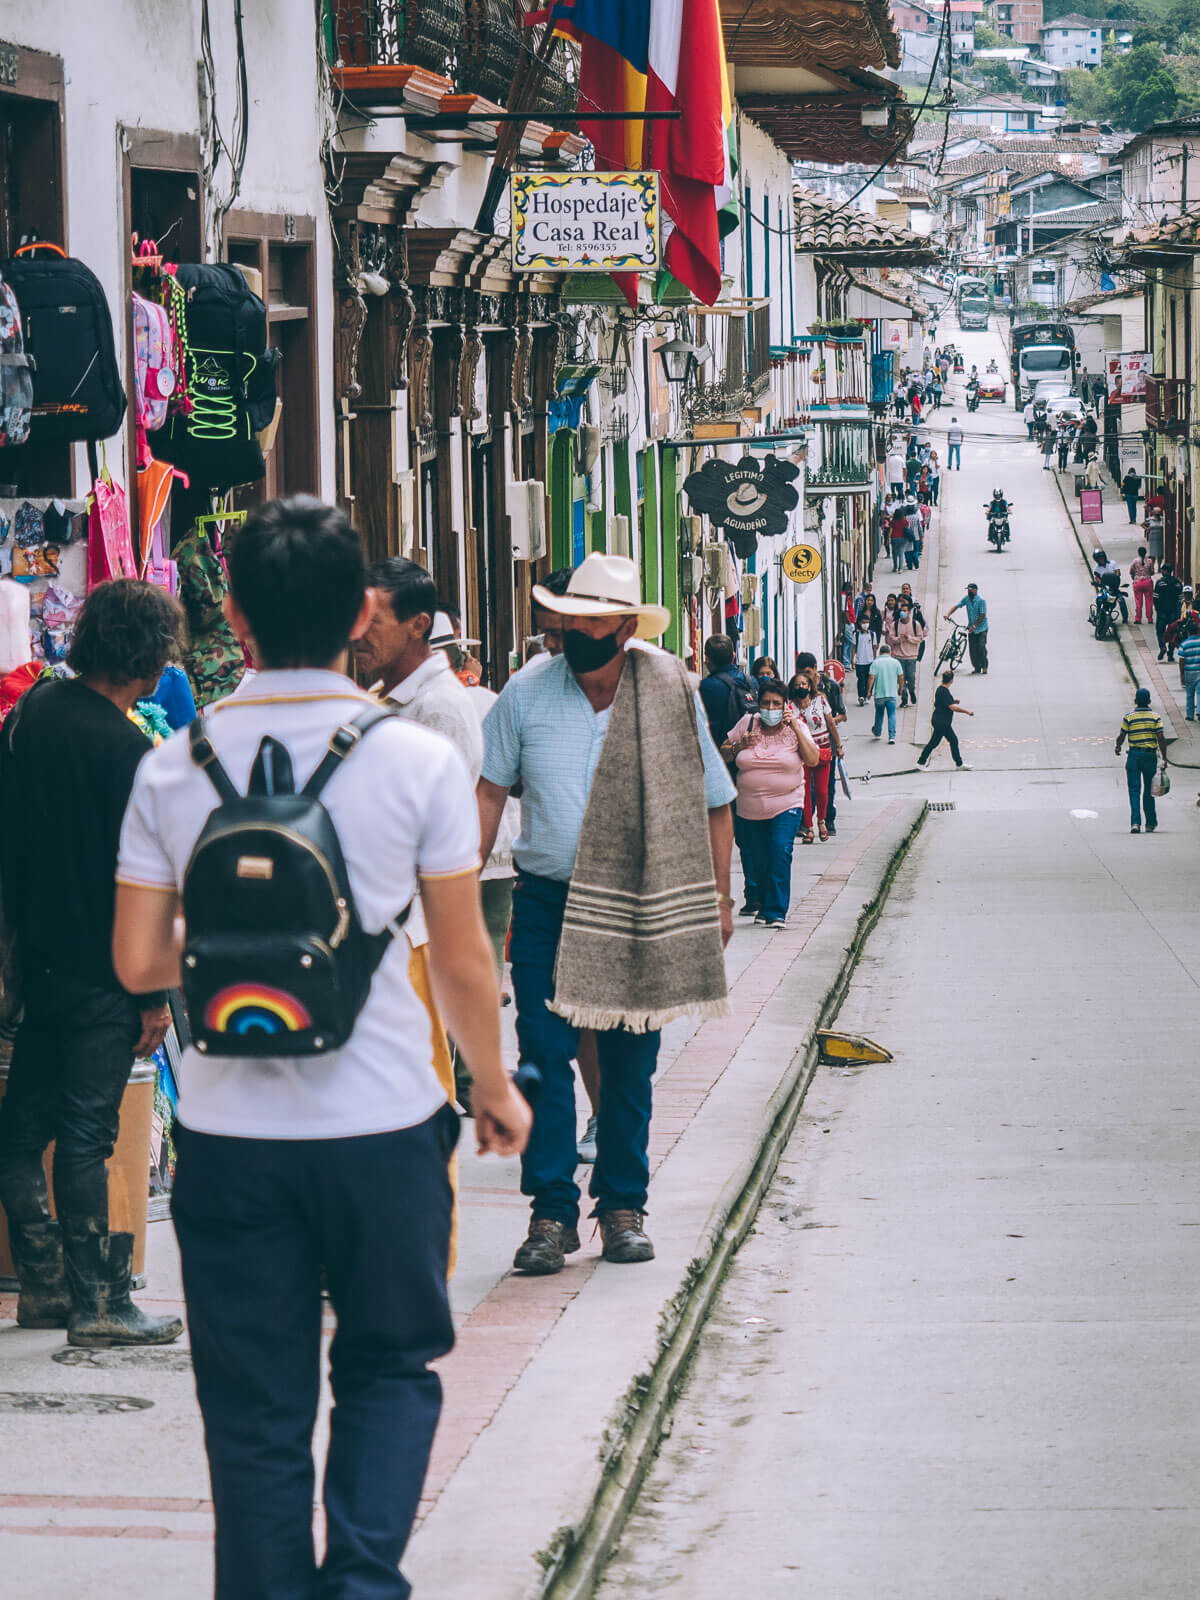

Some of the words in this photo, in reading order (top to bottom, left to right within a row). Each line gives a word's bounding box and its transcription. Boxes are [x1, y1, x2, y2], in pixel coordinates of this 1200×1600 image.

[533, 192, 637, 221] Hospedaje
[533, 221, 584, 241] Casa
[592, 221, 639, 241] Real
[558, 243, 573, 252] Tel:
[576, 243, 617, 252] 8596355
[724, 470, 765, 484] LEGITIMO
[723, 516, 767, 531] AGUADEÑO
[789, 568, 816, 579] efecty
